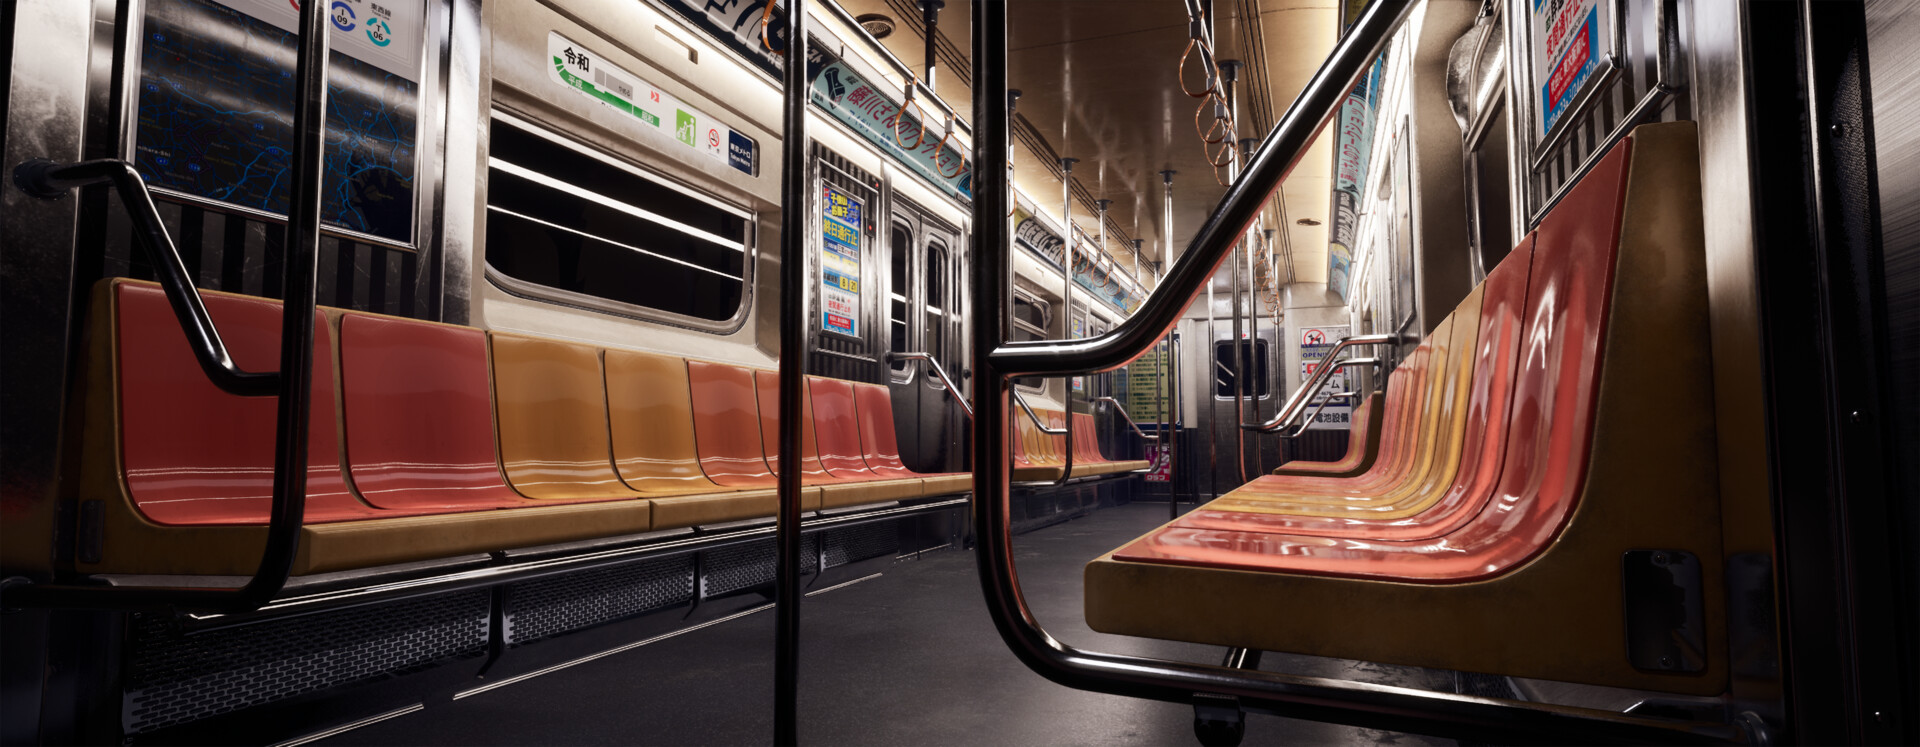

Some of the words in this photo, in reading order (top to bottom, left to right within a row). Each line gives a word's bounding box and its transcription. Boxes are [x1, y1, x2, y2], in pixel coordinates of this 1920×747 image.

[371, 3, 391, 17] 東西線
[336, 15, 348, 25] 09
[373, 31, 383, 41] 06
[564, 46, 589, 72] 令和
